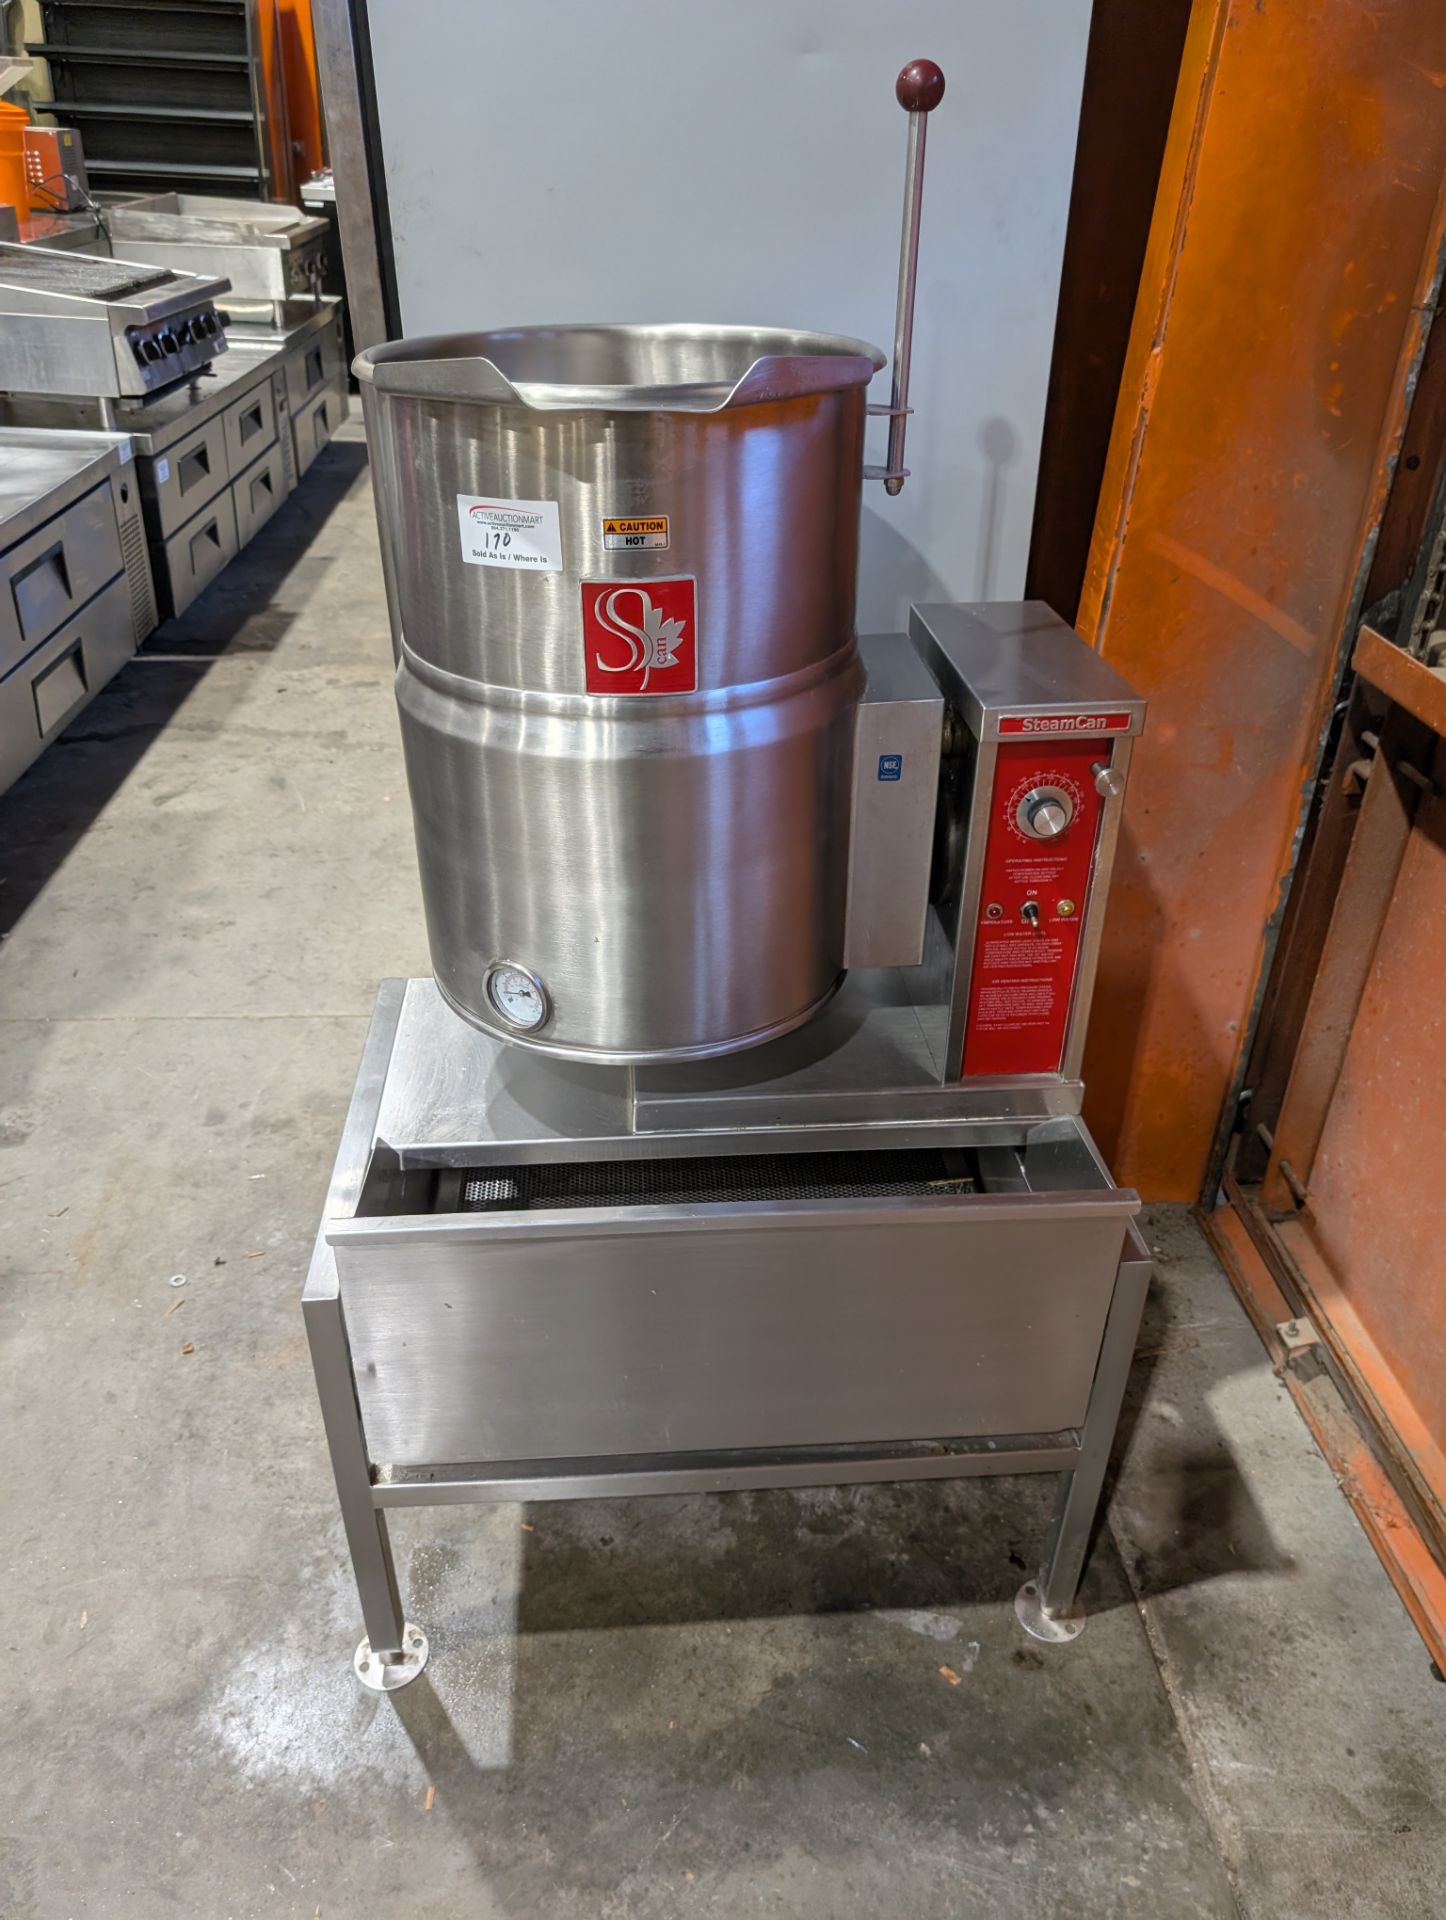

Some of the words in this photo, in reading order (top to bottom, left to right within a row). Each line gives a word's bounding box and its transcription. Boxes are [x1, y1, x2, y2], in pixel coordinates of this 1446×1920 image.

[472, 511, 544, 525] ACTIVEAUCTIONMART
[619, 521, 664, 532] CAUTION
[485, 532, 512, 550] 170
[625, 536, 646, 546] HOT
[472, 549, 487, 558] Sold
[488, 551, 498, 560] As
[513, 554, 539, 563] Where
[1022, 716, 1107, 731] SteamCan
